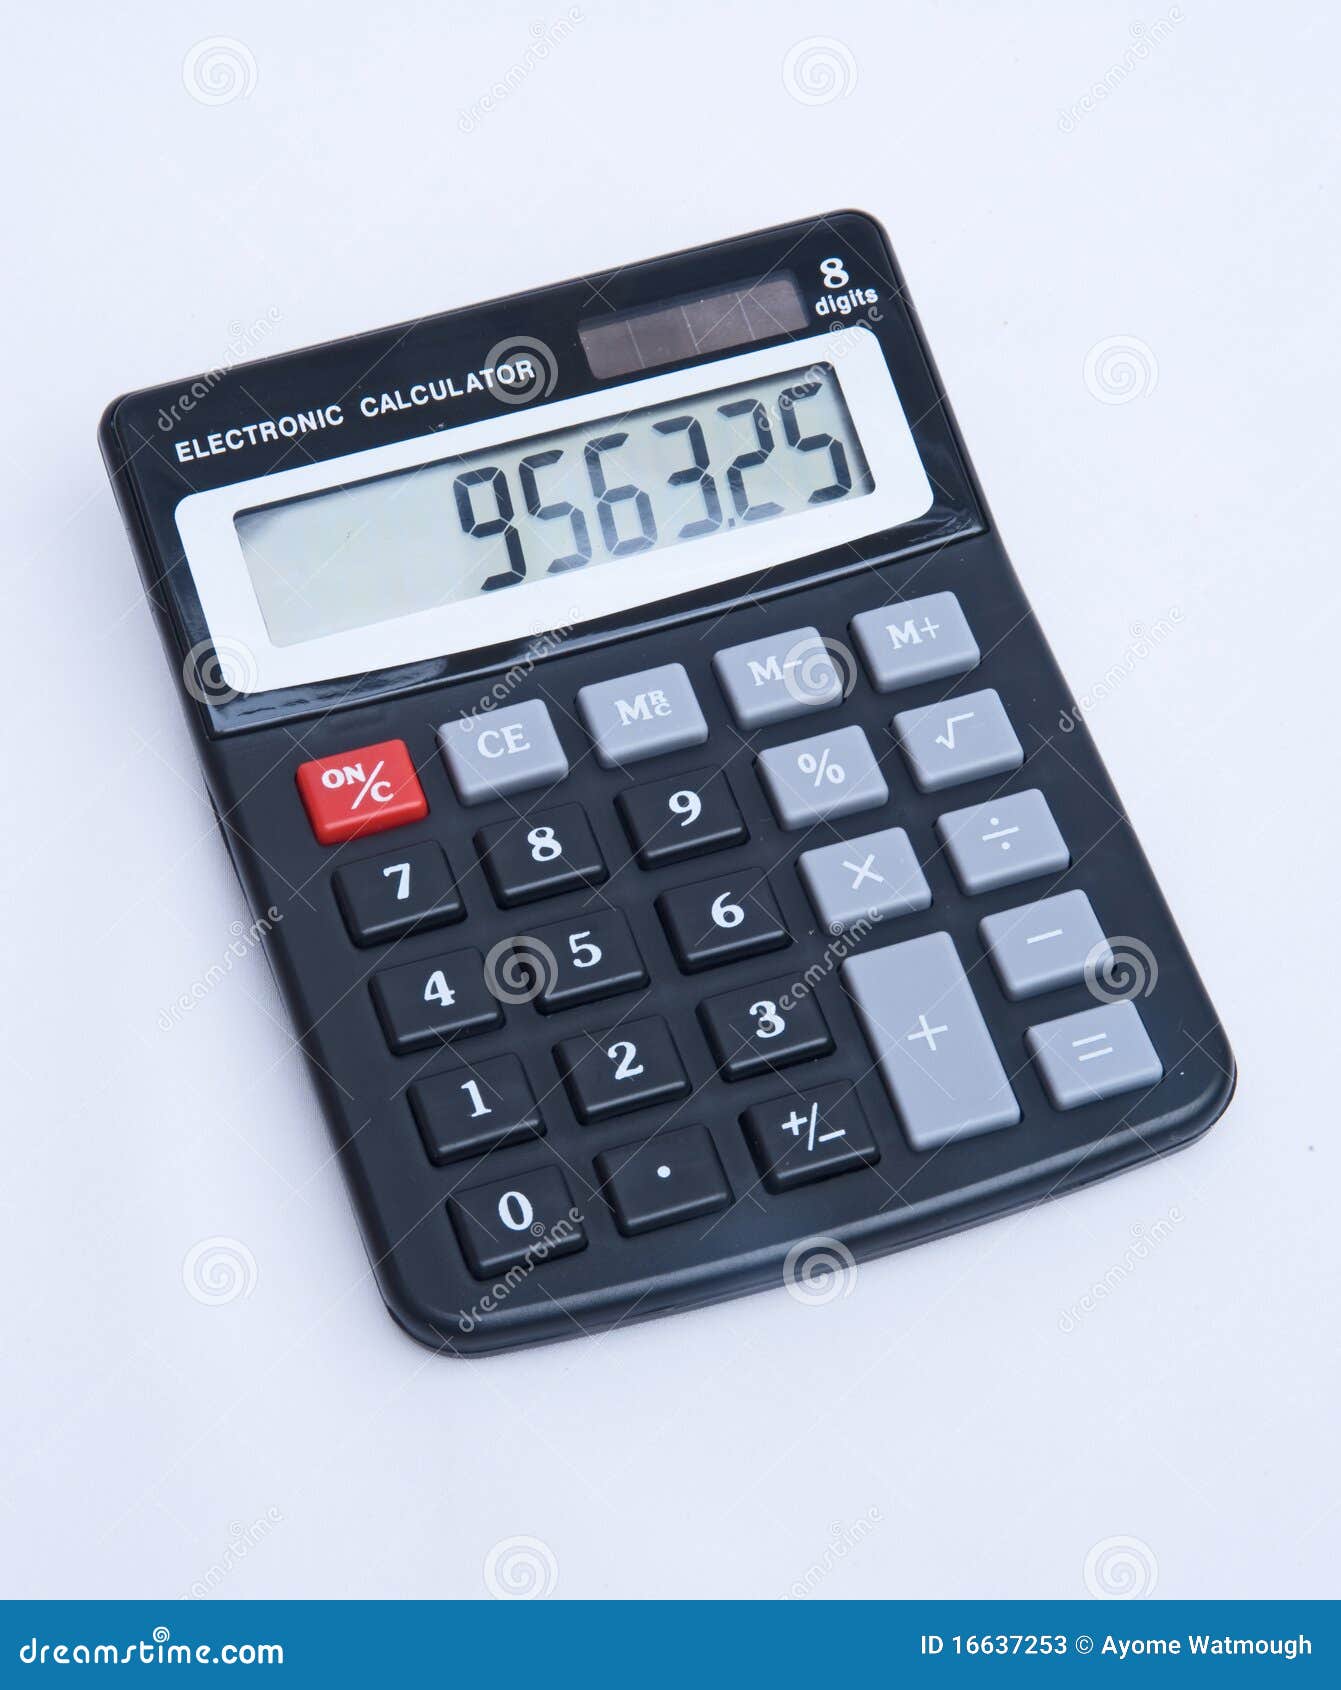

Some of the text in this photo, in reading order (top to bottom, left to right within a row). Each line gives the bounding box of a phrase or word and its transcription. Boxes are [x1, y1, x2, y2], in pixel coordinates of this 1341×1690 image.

[820, 258, 849, 288] 8
[815, 285, 878, 316] digits
[175, 359, 535, 463] ELECTRONIC CALCULATOR
[886, 615, 941, 650] M+
[477, 723, 531, 760] CE
[797, 747, 846, 787] %
[668, 789, 702, 827] 9
[526, 826, 562, 863] 8
[382, 861, 412, 900] 7
[710, 891, 745, 929] 6
[568, 930, 603, 968] 5
[423, 970, 455, 1008] 4
[749, 1000, 786, 1038] 3
[607, 1040, 644, 1080] 2
[460, 1078, 492, 1118] 1
[498, 1190, 534, 1231] 0
